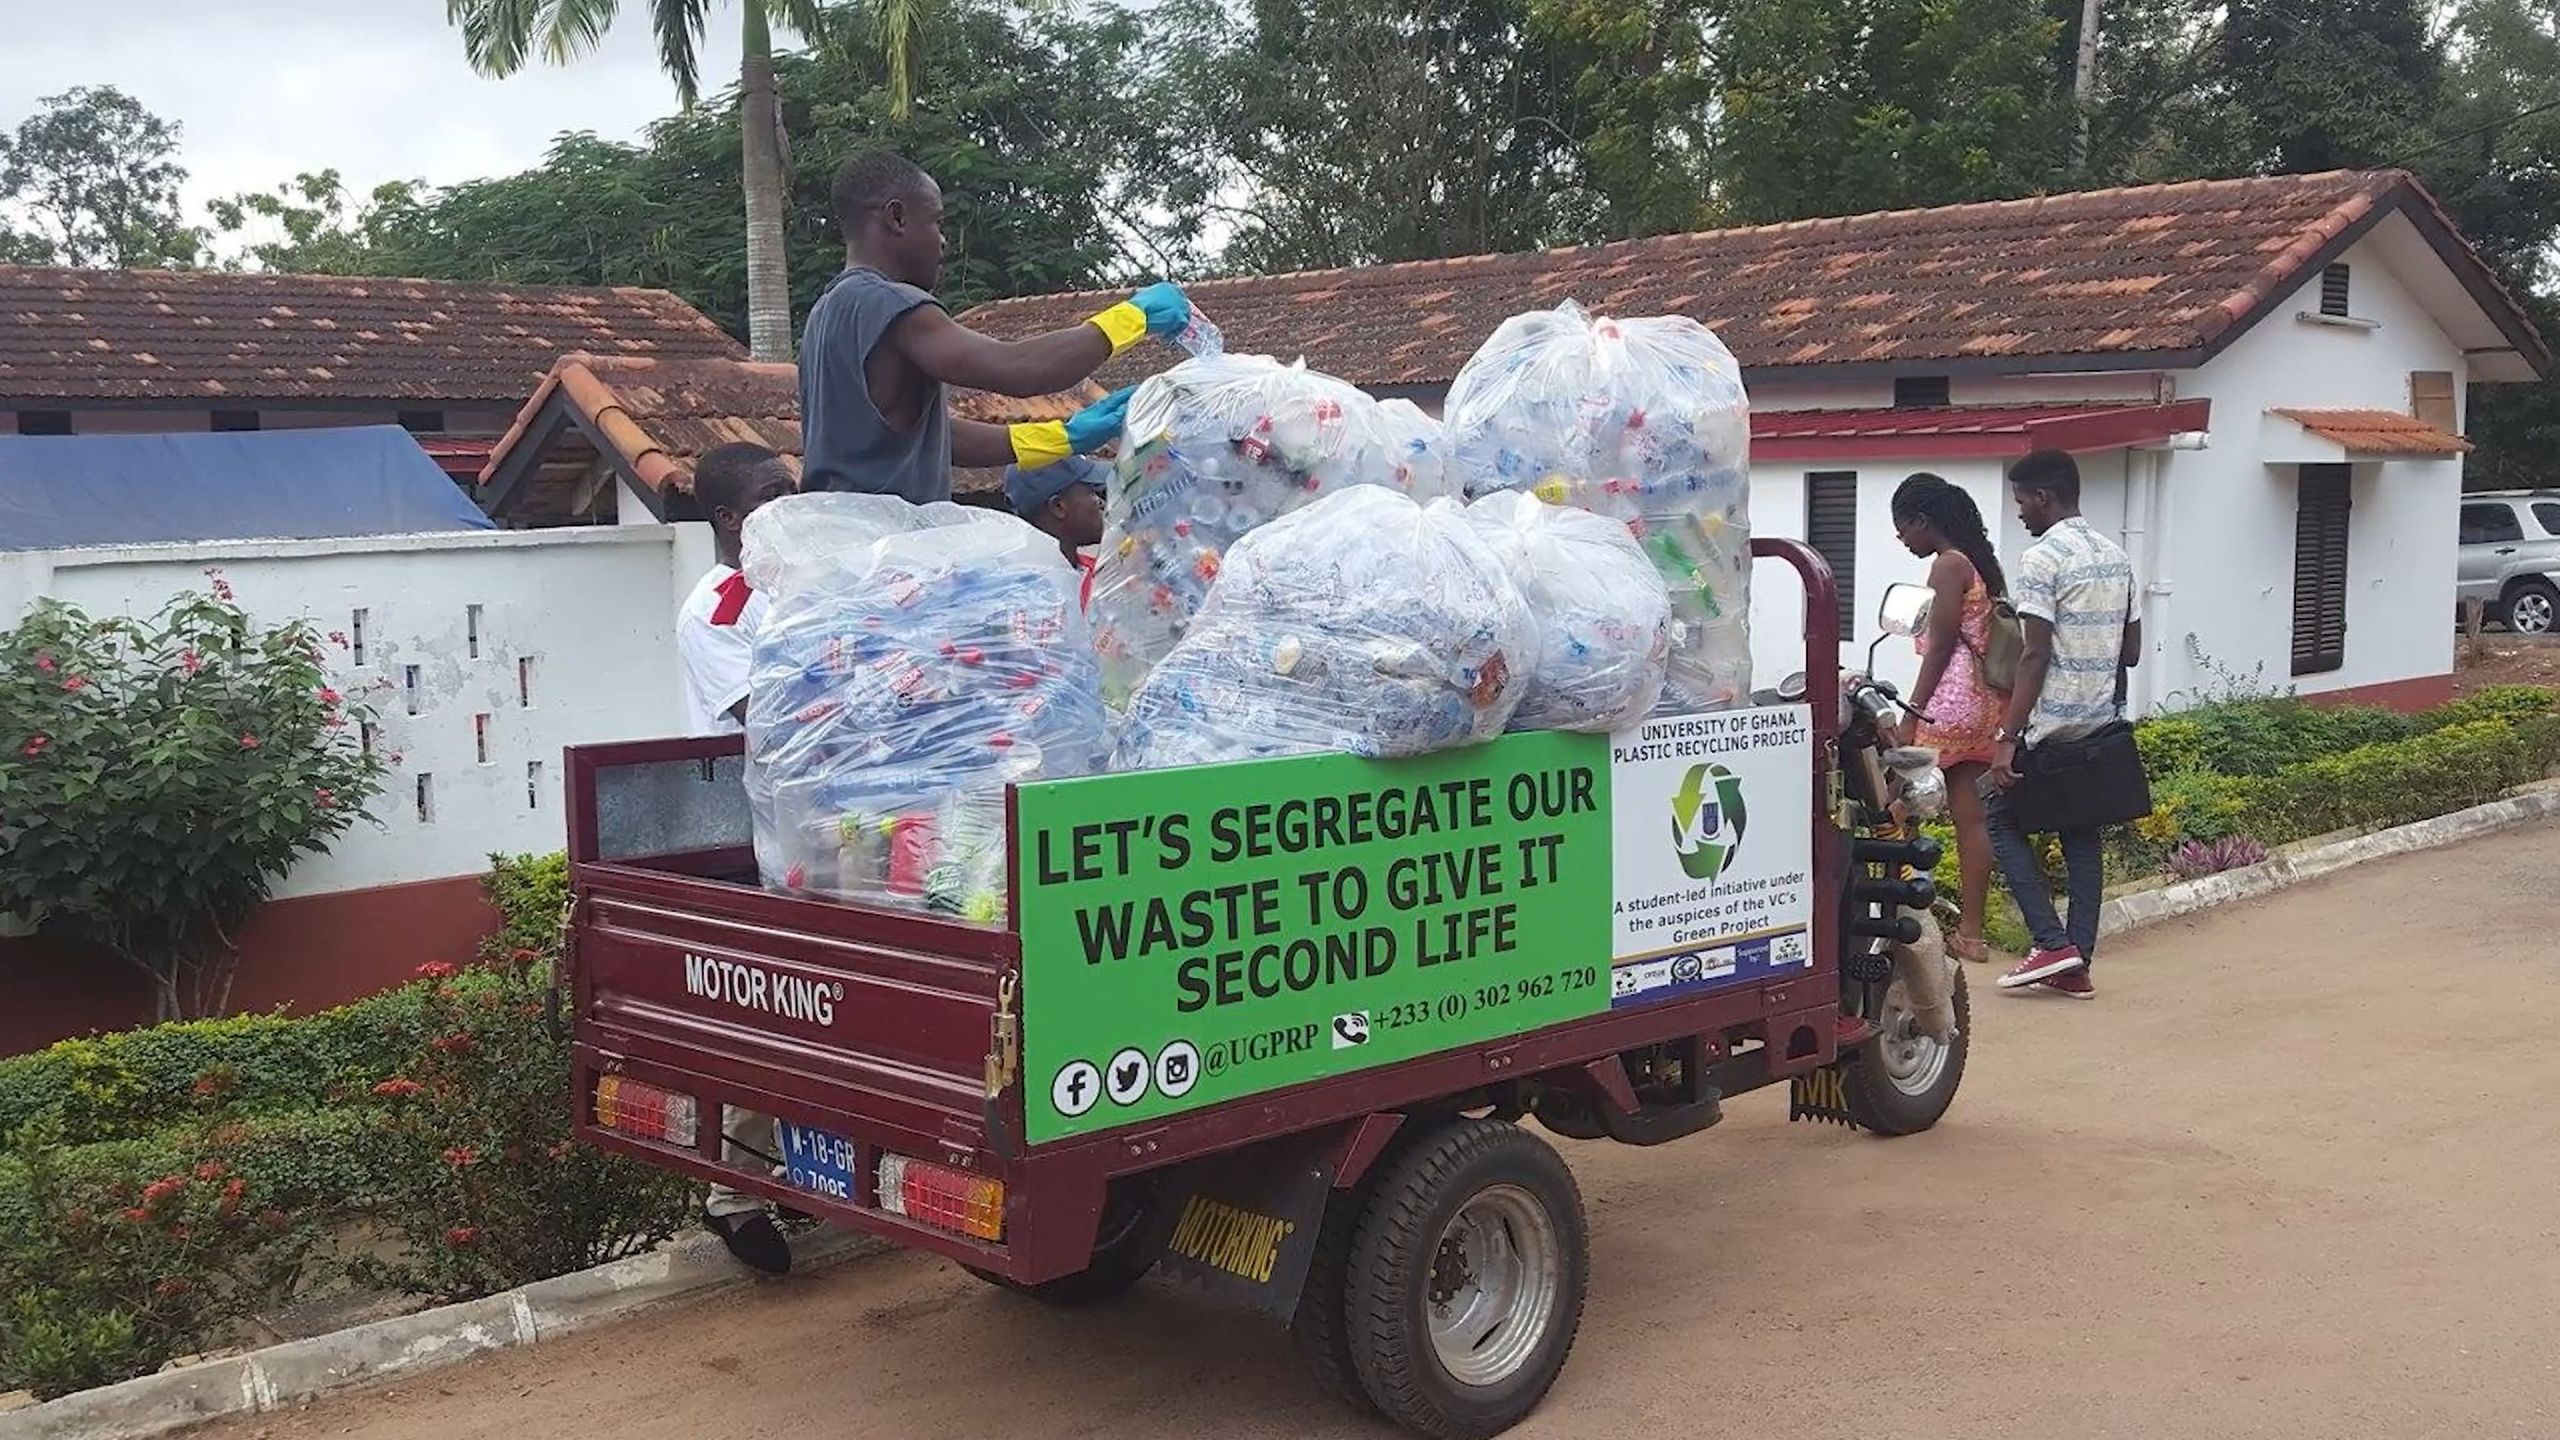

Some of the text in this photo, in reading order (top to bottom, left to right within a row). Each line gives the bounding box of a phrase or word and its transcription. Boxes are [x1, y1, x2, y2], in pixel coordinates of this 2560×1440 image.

[1614, 728, 1806, 763] PLASTIC RECYCLING PROJECT
[1642, 712, 1796, 741] UNIVERSITY OF GHANA
[1038, 814, 1191, 886] LET'S
[1210, 778, 1492, 863] SEGREGATE
[1507, 766, 1597, 822] OUR
[1075, 834, 1565, 965] WASTE TO GIVE IT
[1614, 871, 1805, 914] A student-led initiative under
[1629, 918, 1653, 932] the
[1659, 907, 1720, 927] auspices
[1725, 901, 1738, 915] of
[1743, 896, 1765, 911] the
[1673, 915, 1770, 943] Green Project
[685, 953, 769, 1012] MOTOR
[1177, 904, 1517, 1014] SECOND LIFE
[1374, 966, 1596, 1030] +233 (0) 302 962 720
[1204, 1024, 1319, 1077] @UGPRP
[1798, 1066, 1850, 1112] MK
